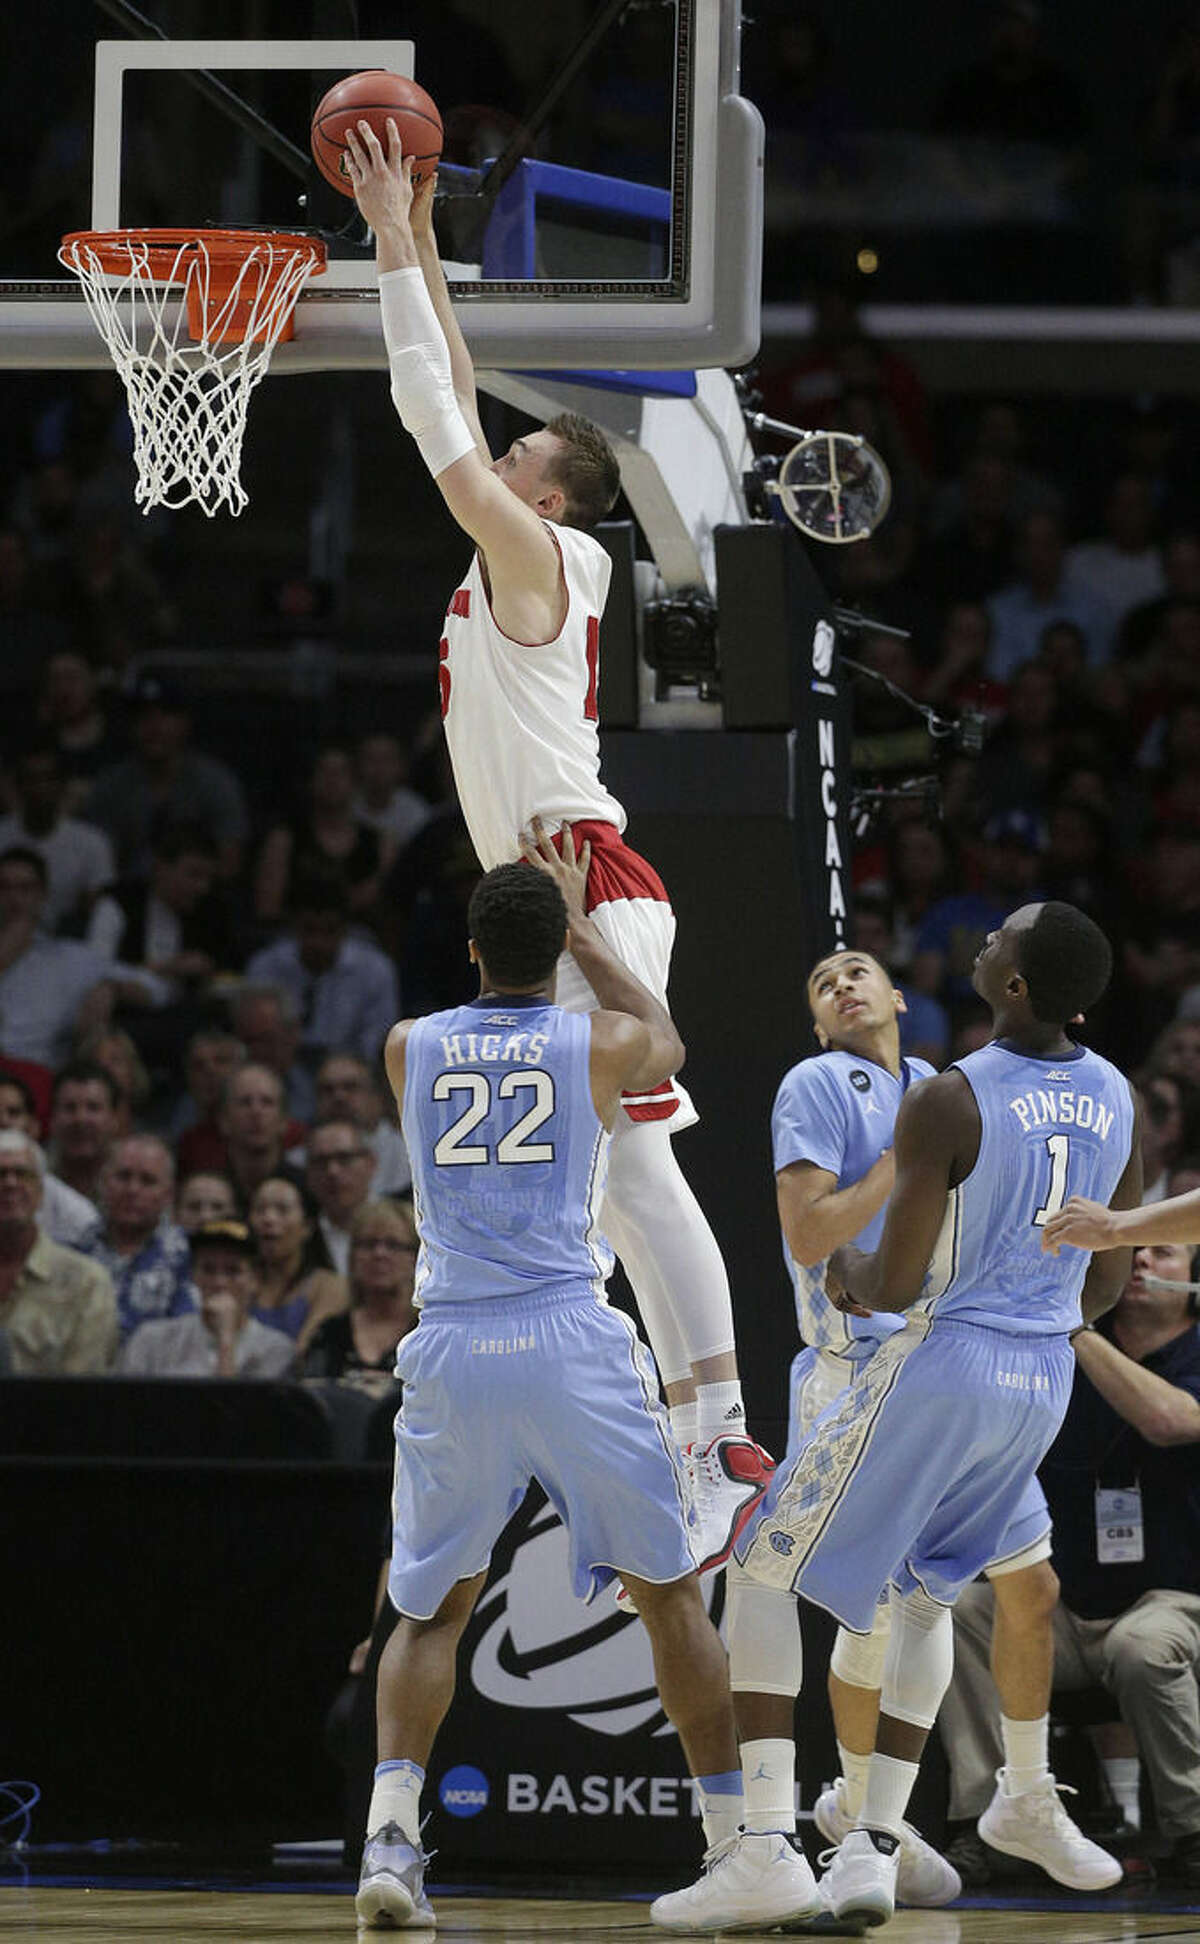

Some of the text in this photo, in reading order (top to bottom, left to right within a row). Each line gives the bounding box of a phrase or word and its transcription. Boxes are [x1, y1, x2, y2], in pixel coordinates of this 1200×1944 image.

[481, 1015, 519, 1027] ACC
[440, 1032, 550, 1067] HICKS
[1043, 1070, 1073, 1081] ACC
[432, 1068, 555, 1166] 22
[1009, 1089, 1115, 1141] PINSON
[1032, 1133, 1070, 1227] 1
[471, 1334, 536, 1355] CAROLINA
[1106, 1528, 1134, 1539] CBS
